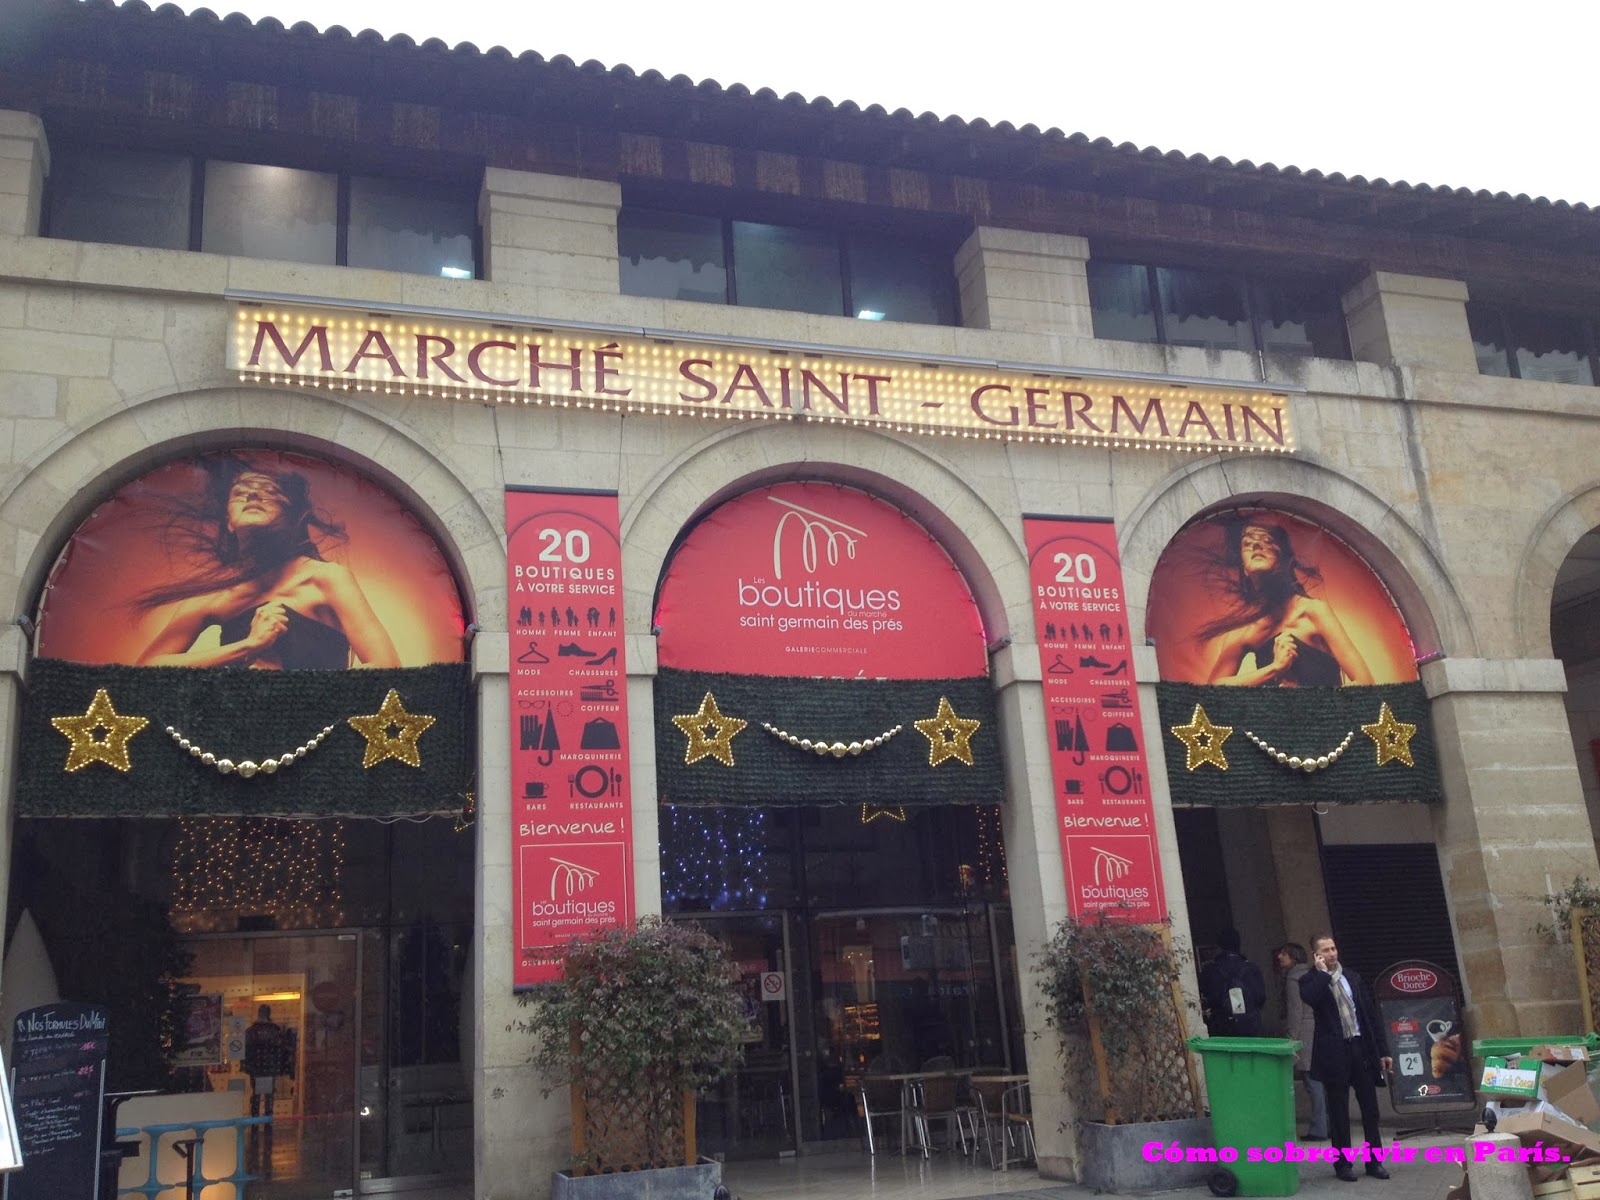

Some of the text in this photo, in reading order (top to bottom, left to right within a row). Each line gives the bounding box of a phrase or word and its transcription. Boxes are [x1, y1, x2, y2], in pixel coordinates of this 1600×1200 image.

[247, 321, 632, 397] MARCHÉ
[678, 358, 892, 417] SAINT
[970, 384, 1285, 447] GERMAIN
[538, 528, 591, 563] 20
[515, 565, 615, 581] BOUTIQUES
[1053, 552, 1097, 584] 20
[516, 580, 615, 595] À VOTRE SERVICE
[753, 576, 766, 584] Les
[738, 578, 901, 615] boutiques
[1037, 585, 1119, 599] BOUTIQUES
[1040, 599, 1121, 612] À VOTRE SERVICE
[739, 613, 903, 634] saint germain des prés
[588, 630, 617, 638] ENFANT
[568, 669, 618, 677] CHAUSSURES
[517, 689, 574, 697] ACCESSOIRES
[560, 753, 622, 761] MAROQUINERIE
[570, 802, 624, 810] RESTAURANTS
[1063, 813, 1142, 828] Bienvenue
[520, 820, 616, 837] Bienvenue
[1081, 885, 1149, 901] boutiques
[532, 899, 616, 917] boutiques
[533, 918, 551, 927] saint
[552, 916, 584, 928] germain
[585, 916, 599, 924] des
[1397, 969, 1431, 983] Brioche
